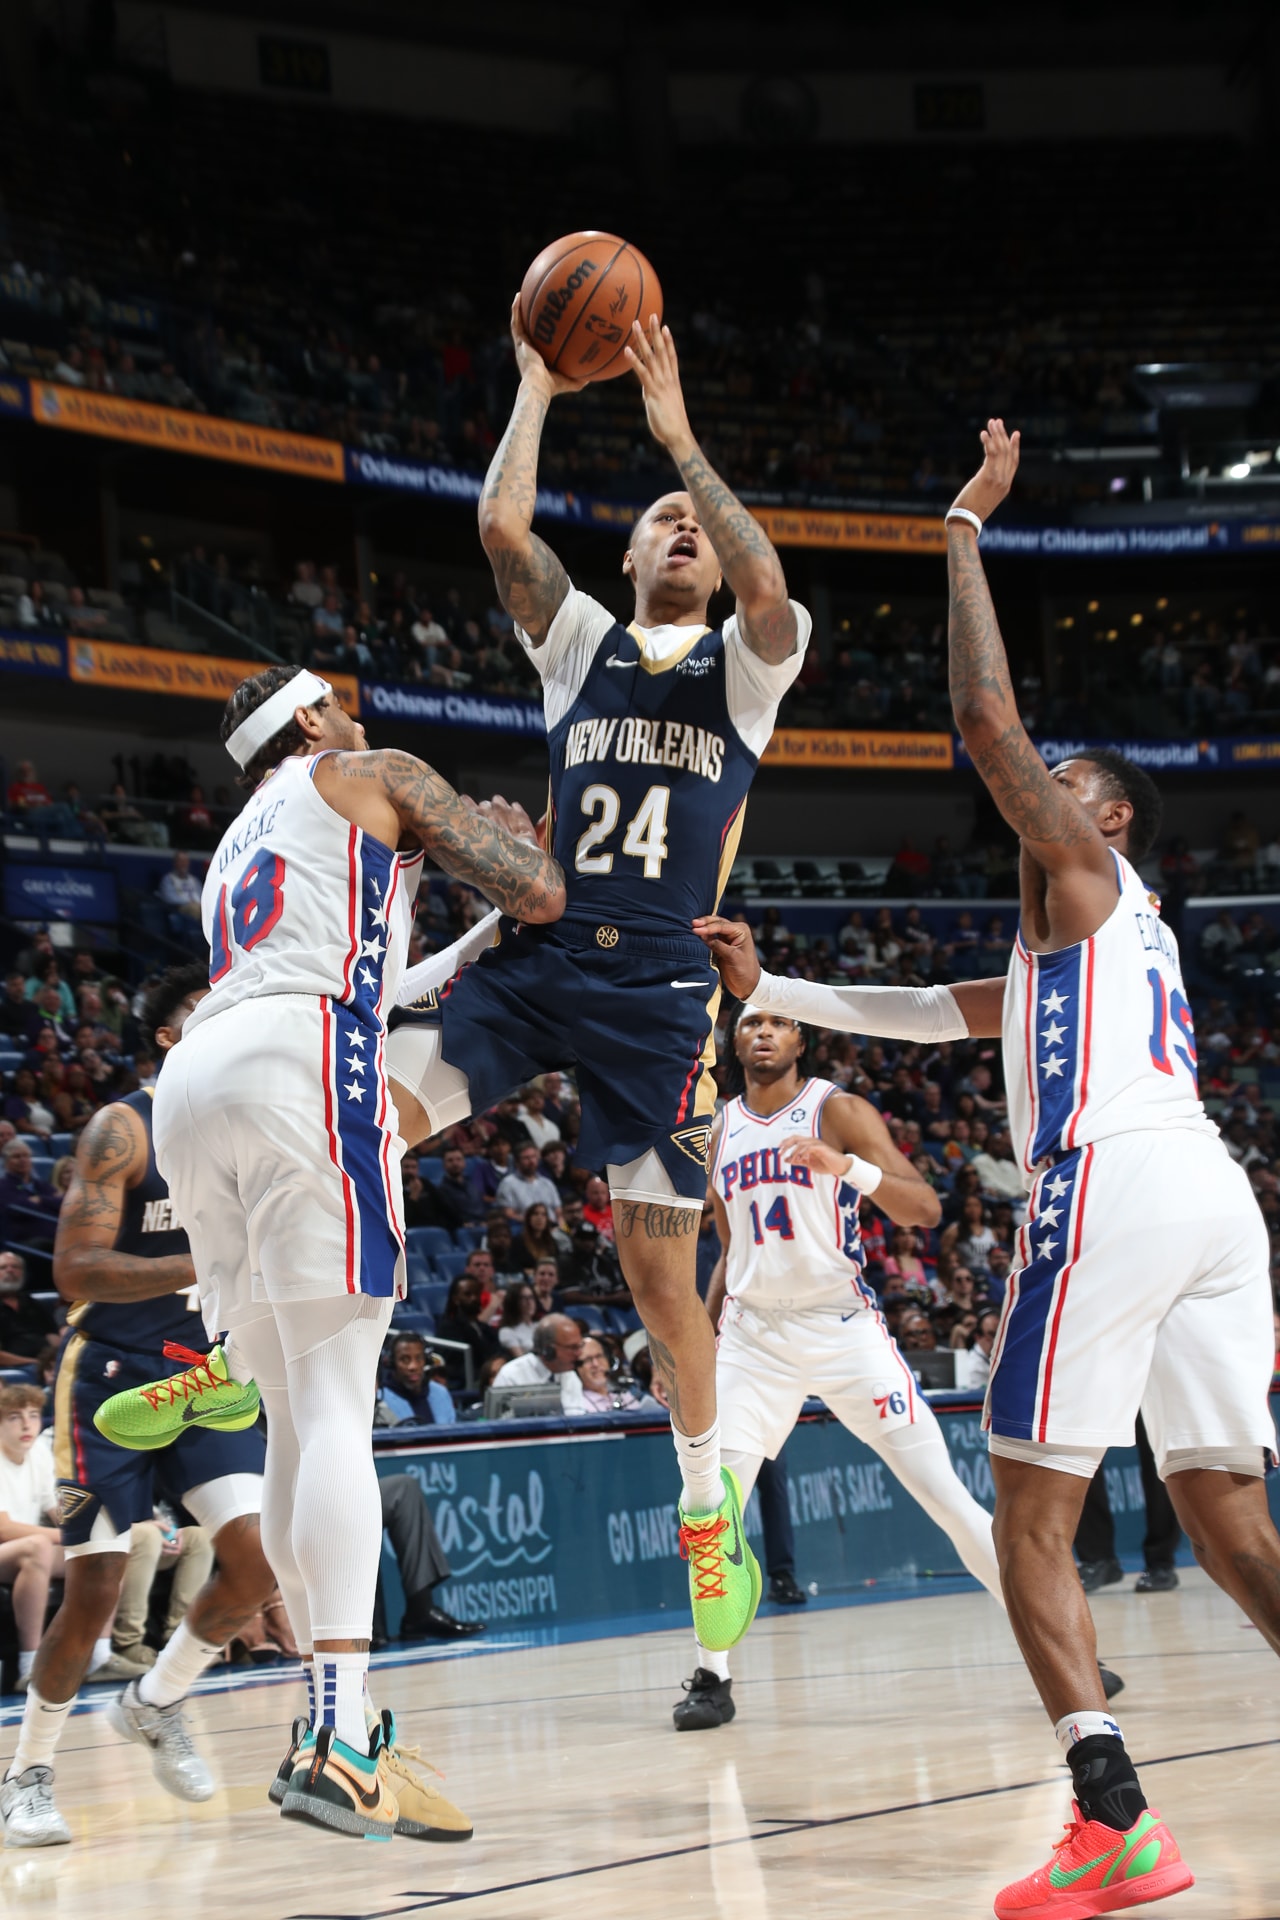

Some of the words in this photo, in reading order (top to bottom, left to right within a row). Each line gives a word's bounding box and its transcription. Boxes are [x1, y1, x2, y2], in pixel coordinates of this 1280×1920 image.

[533, 258, 598, 345] Wilson
[360, 454, 426, 488] Ochsner
[1041, 526, 1127, 551] Children's
[1129, 524, 1209, 552] Hospital
[371, 685, 442, 715] Ochsner
[445, 695, 525, 728] Children's
[564, 717, 619, 770] NEW
[614, 717, 726, 784] ORLEANS
[783, 737, 807, 755] for
[812, 738, 848, 757] Kids
[851, 739, 867, 757] in
[868, 740, 948, 760] Louisiana
[1124, 742, 1199, 768] Hospital
[574, 783, 671, 879] 24
[208, 846, 286, 985] 18
[749, 1195, 795, 1245] 14
[872, 1391, 907, 1420] 76
[405, 1461, 457, 1495] PLAY
[606, 1510, 634, 1565] GO
[845, 1461, 894, 1515] SAKE.
[441, 1574, 558, 1622] MISSISSIPPI
